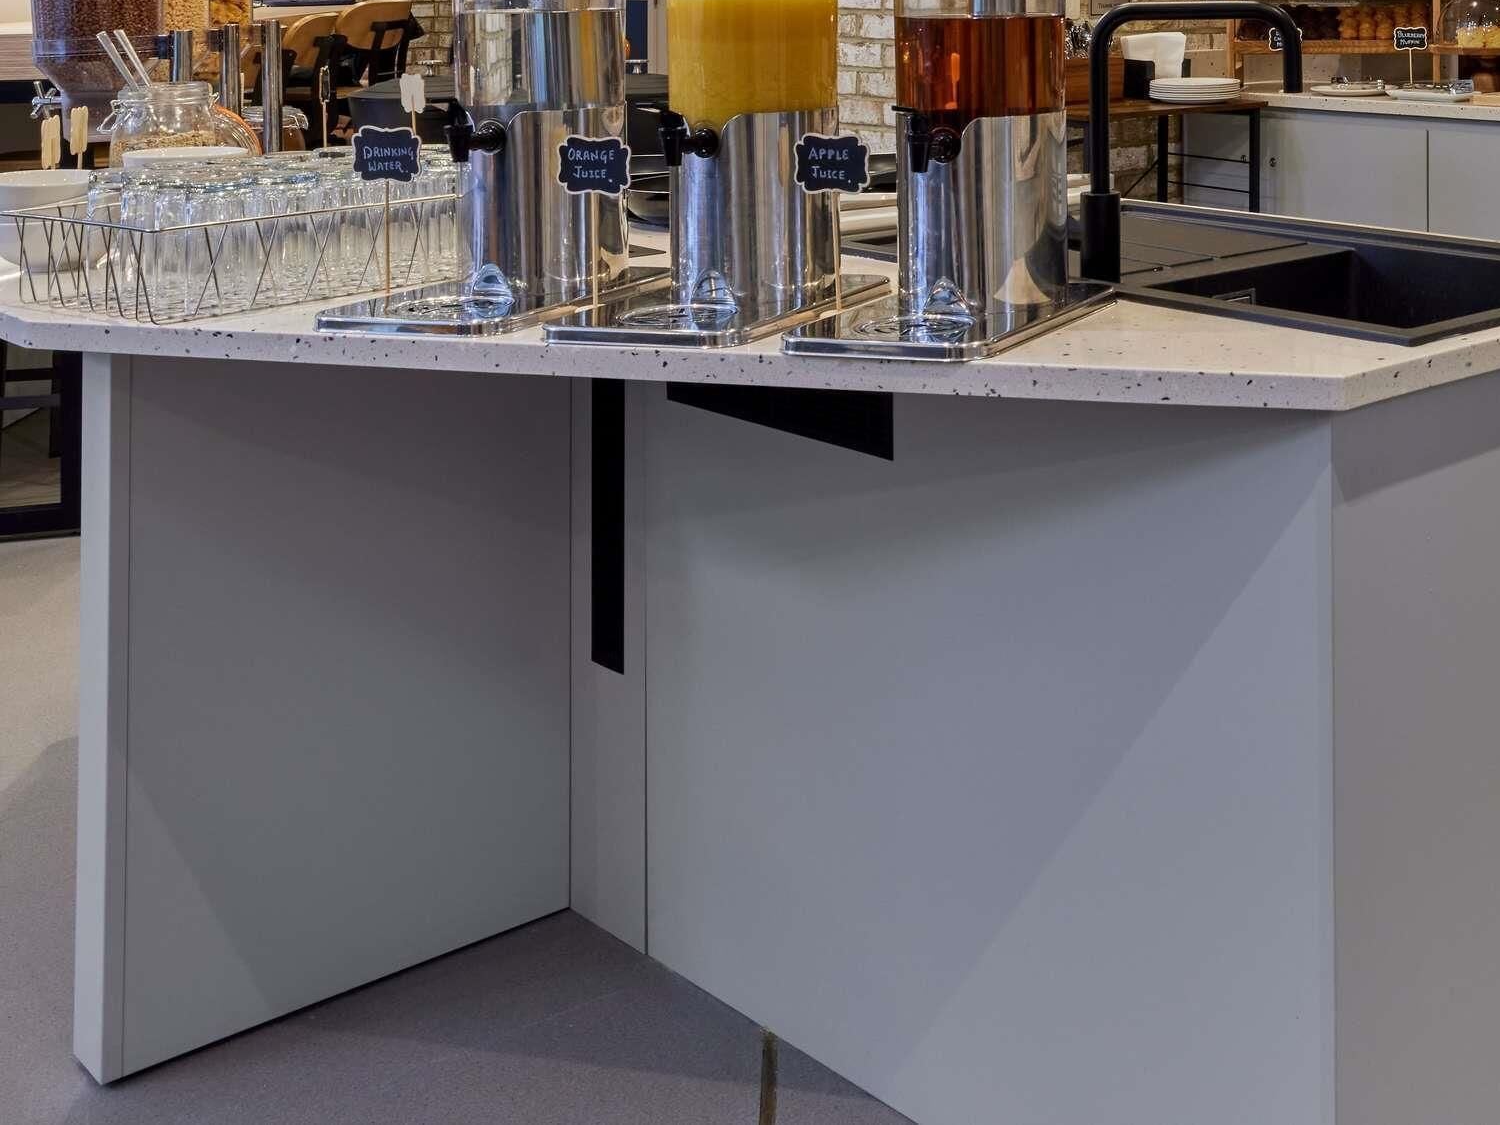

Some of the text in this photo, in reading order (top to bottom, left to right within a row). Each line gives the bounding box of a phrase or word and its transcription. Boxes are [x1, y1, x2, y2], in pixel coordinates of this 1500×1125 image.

[363, 145, 414, 161] DRINKING
[567, 147, 615, 164] ORANGE
[808, 146, 849, 161] APPLE
